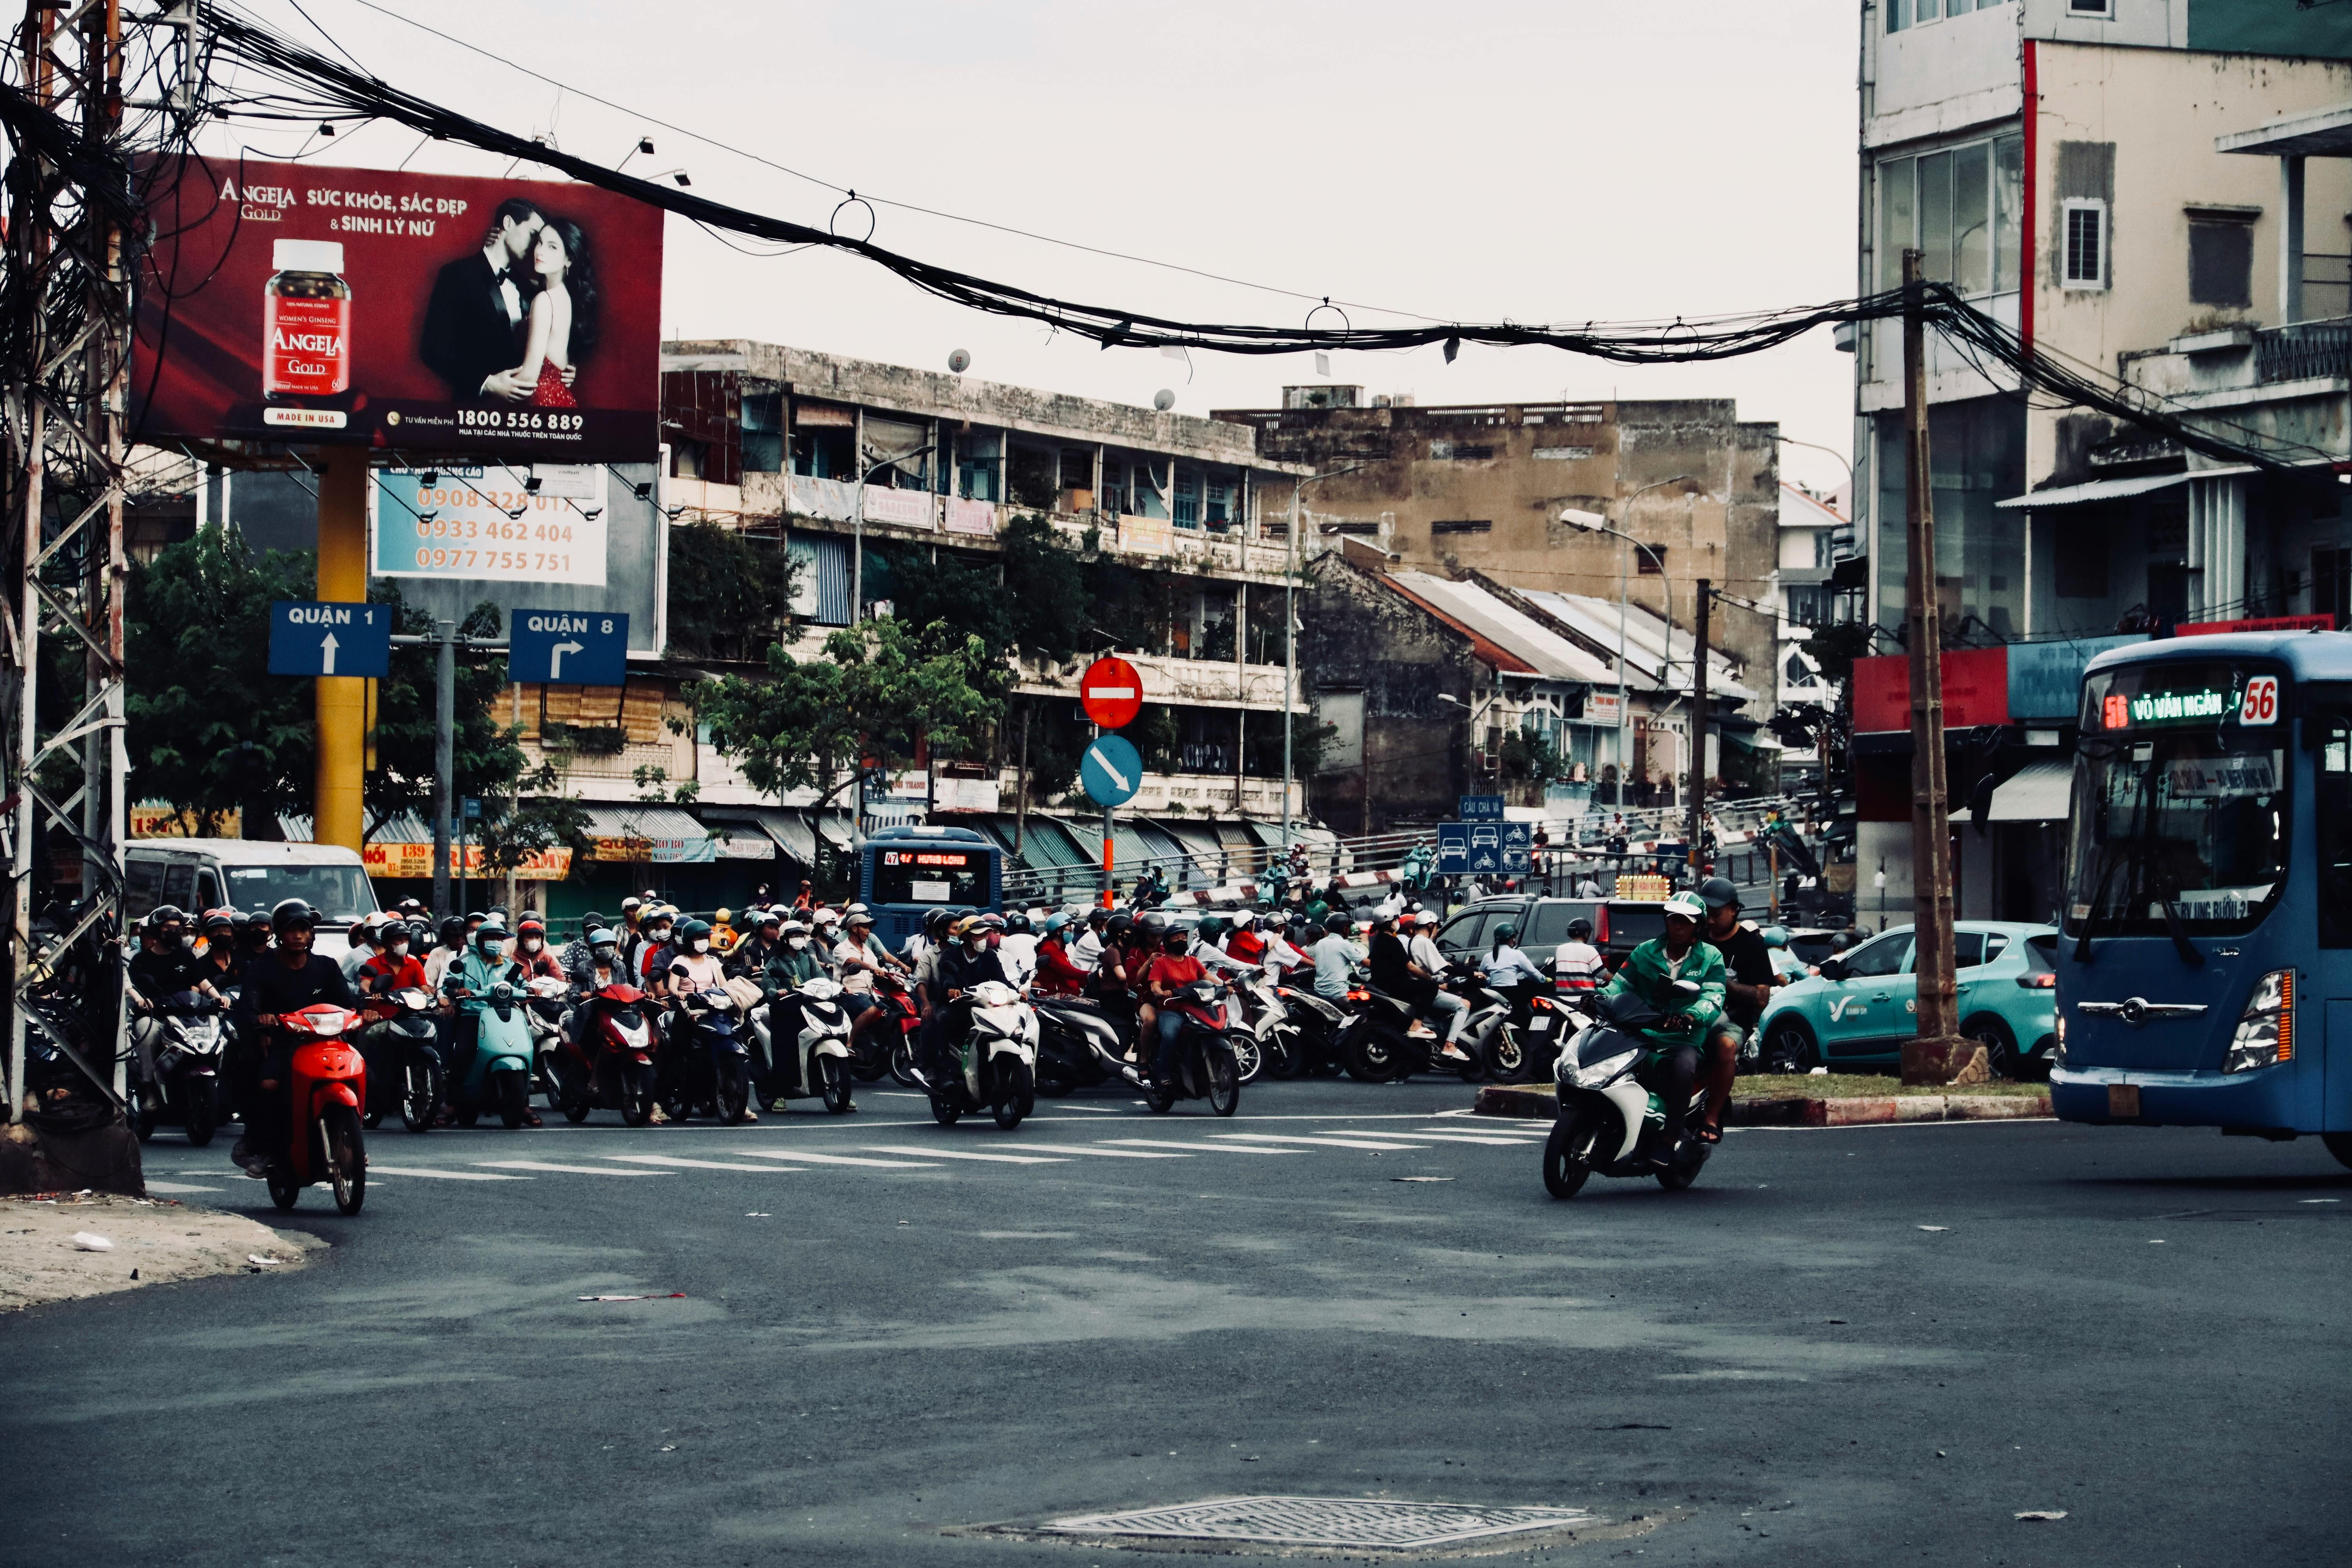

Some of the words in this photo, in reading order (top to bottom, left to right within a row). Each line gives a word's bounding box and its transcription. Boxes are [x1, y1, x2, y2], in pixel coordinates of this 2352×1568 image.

[307, 188, 341, 206] SỨC
[345, 191, 397, 213] KHỎE,
[400, 192, 433, 212] SẮC
[436, 198, 467, 218] ĐẸP
[330, 219, 338, 230] &
[341, 215, 382, 233] SINH
[386, 217, 405, 234] LÝ
[409, 219, 436, 236] NỮ
[269, 327, 344, 356] ANGELA
[332, 379, 341, 389] 60
[277, 413, 301, 421] MADE
[428, 417, 443, 425] MIỄN
[458, 410, 501, 426] 1800
[507, 413, 542, 428] 556
[548, 414, 583, 430] 889
[511, 430, 531, 438] THUỐC
[566, 432, 582, 441] QUỐC
[465, 466, 481, 477] CÁO
[417, 488, 478, 507] 0908
[486, 492, 528, 509] 328
[417, 520, 477, 538] 0933
[486, 522, 527, 540] 462
[535, 524, 572, 542] 404
[417, 548, 477, 568] 0977
[486, 552, 527, 569] 755
[535, 554, 570, 571] 751
[289, 605, 350, 627] QUẬN
[365, 610, 372, 624] 1
[528, 614, 588, 636] QUẬN
[601, 620, 613, 634] 8
[2245, 682, 2275, 719] 56
[2105, 695, 2128, 728] 56
[402, 845, 425, 857] 139
[887, 855, 897, 864] 47
